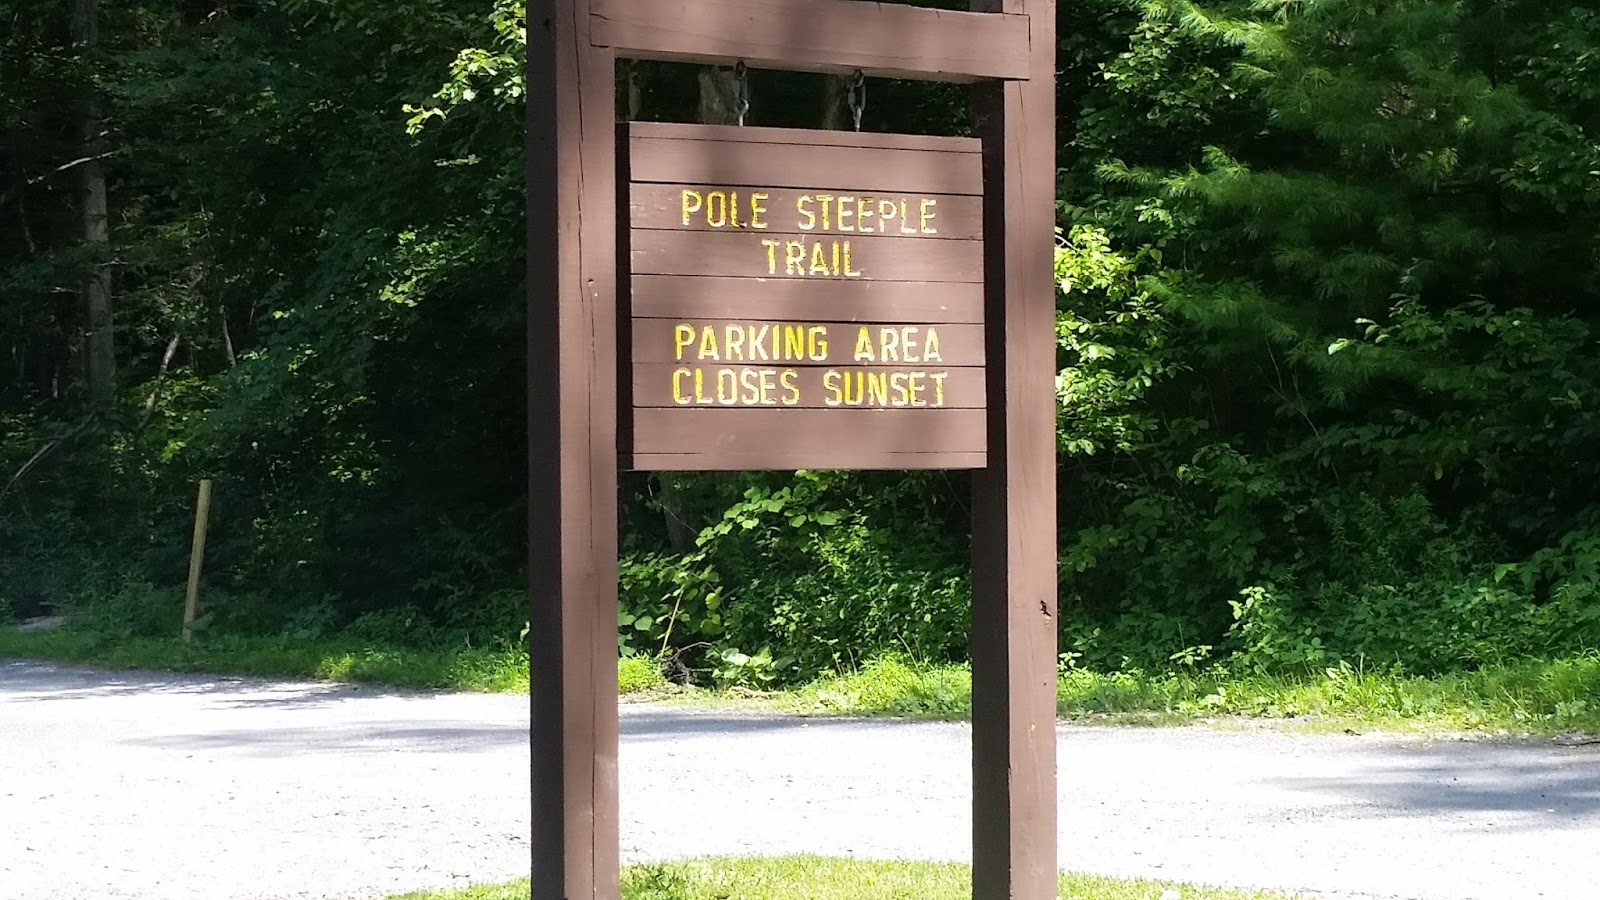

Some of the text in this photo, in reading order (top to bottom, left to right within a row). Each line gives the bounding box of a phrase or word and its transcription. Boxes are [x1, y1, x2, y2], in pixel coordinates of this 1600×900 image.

[681, 188, 938, 234] POLE STEEPLE
[762, 239, 861, 277] TRAIL
[674, 323, 943, 363] PARKING AREA
[672, 367, 948, 407] CLOSES SUNSET
